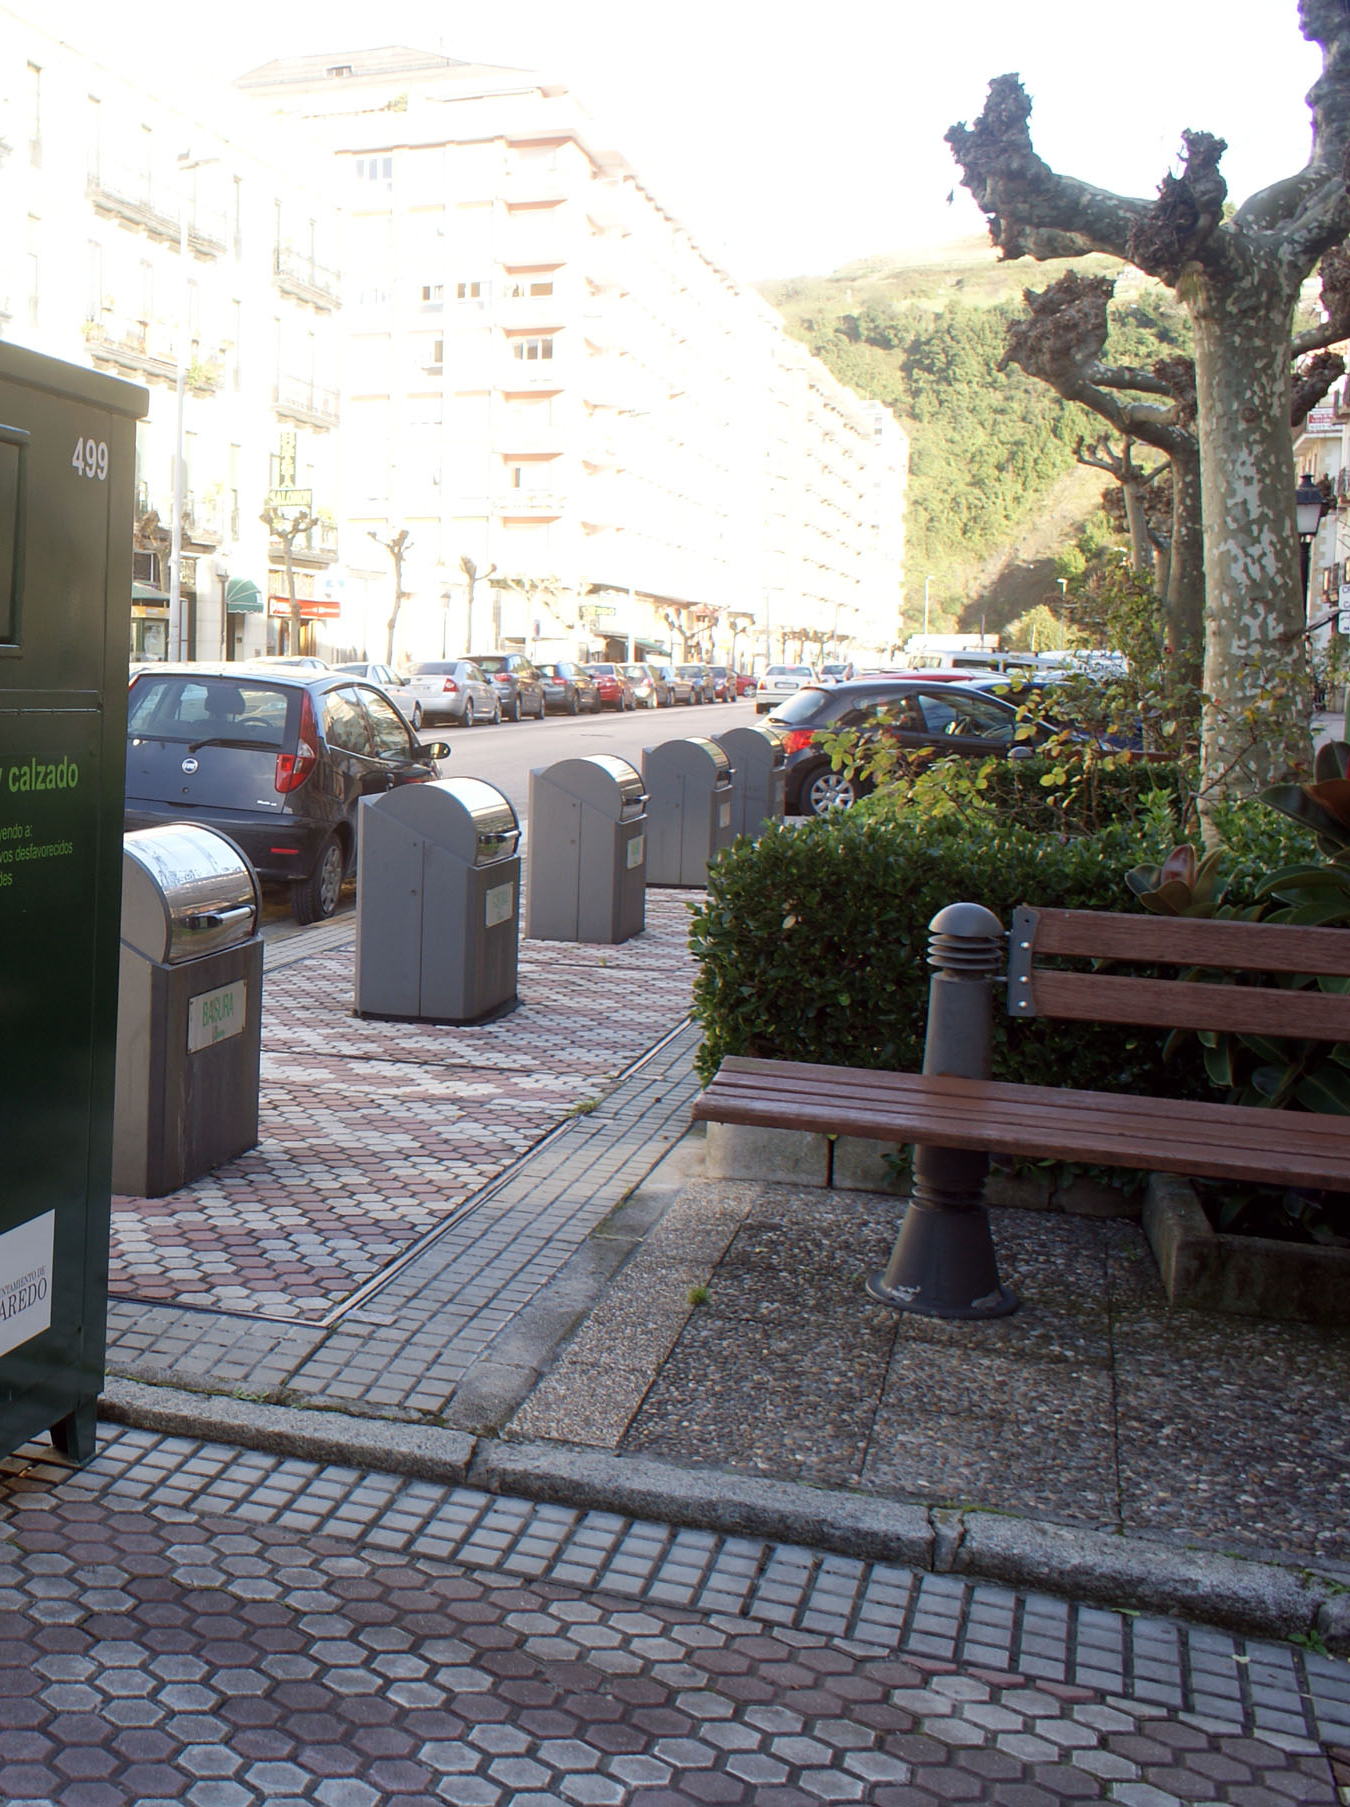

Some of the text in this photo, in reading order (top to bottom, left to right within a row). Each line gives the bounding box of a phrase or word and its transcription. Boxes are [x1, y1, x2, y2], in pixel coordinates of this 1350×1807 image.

[72, 436, 108, 481] 499
[8, 755, 79, 792] calzado
[15, 840, 73, 862] desfavorecidos
